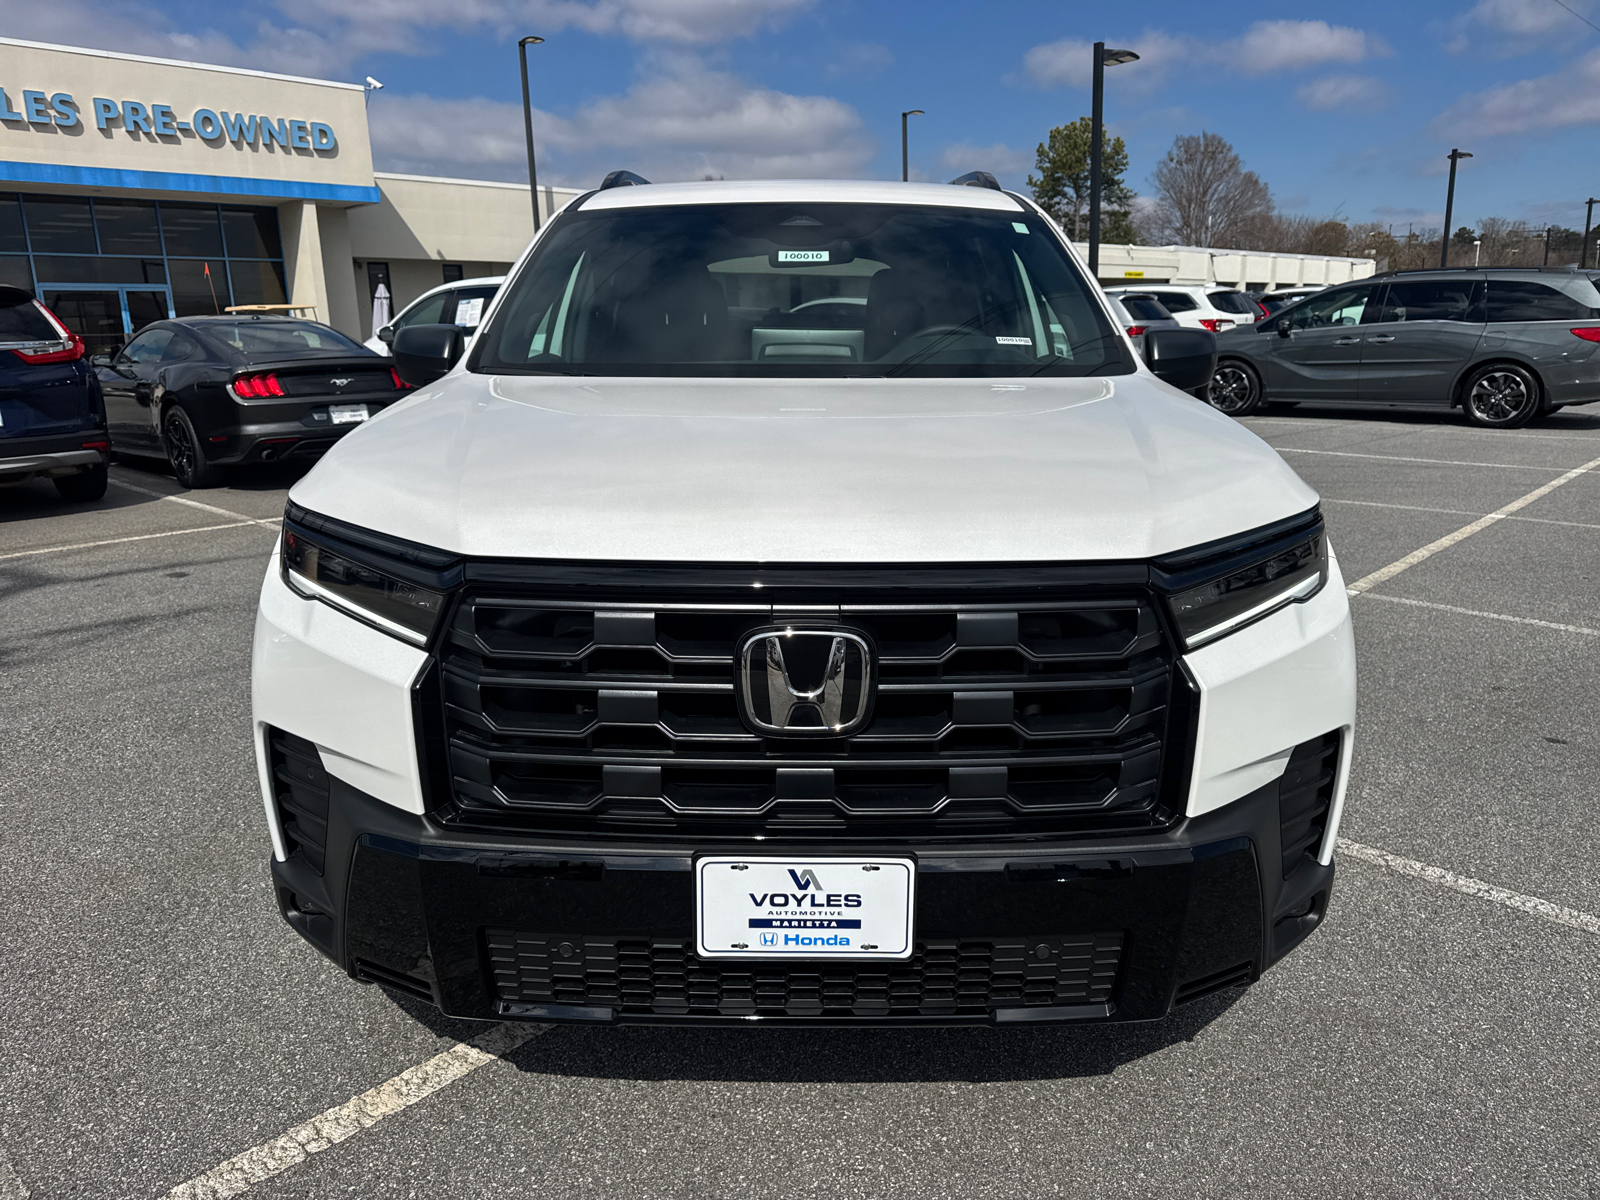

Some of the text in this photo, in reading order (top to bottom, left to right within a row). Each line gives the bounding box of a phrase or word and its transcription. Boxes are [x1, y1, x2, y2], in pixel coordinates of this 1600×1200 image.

[93, 97, 335, 150] PRE-OWNED
[784, 252, 823, 260] 100010
[749, 893, 862, 908] VOYLES
[784, 934, 851, 946] Honda
